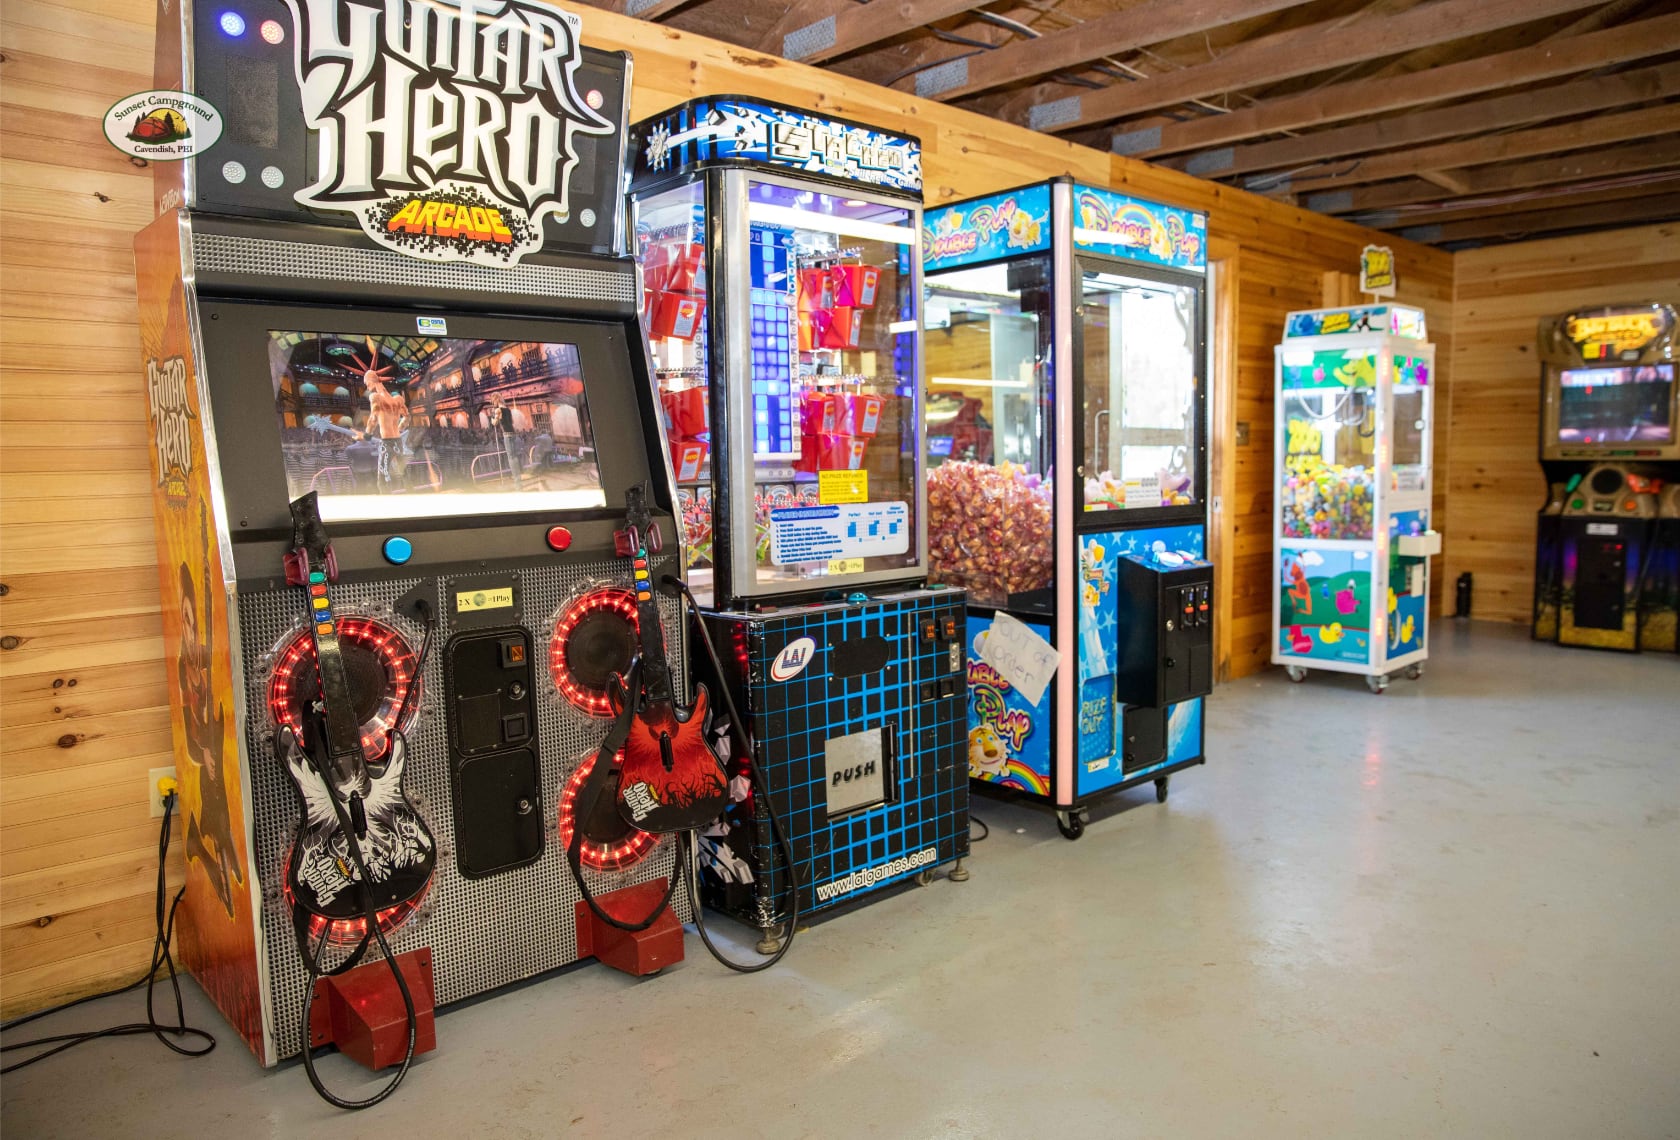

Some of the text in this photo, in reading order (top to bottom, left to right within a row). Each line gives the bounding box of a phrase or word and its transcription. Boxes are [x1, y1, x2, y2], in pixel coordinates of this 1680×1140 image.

[387, 199, 513, 244] ARCADE
[832, 760, 876, 787] PUSH
[816, 847, 937, 901] www.laigames.com
